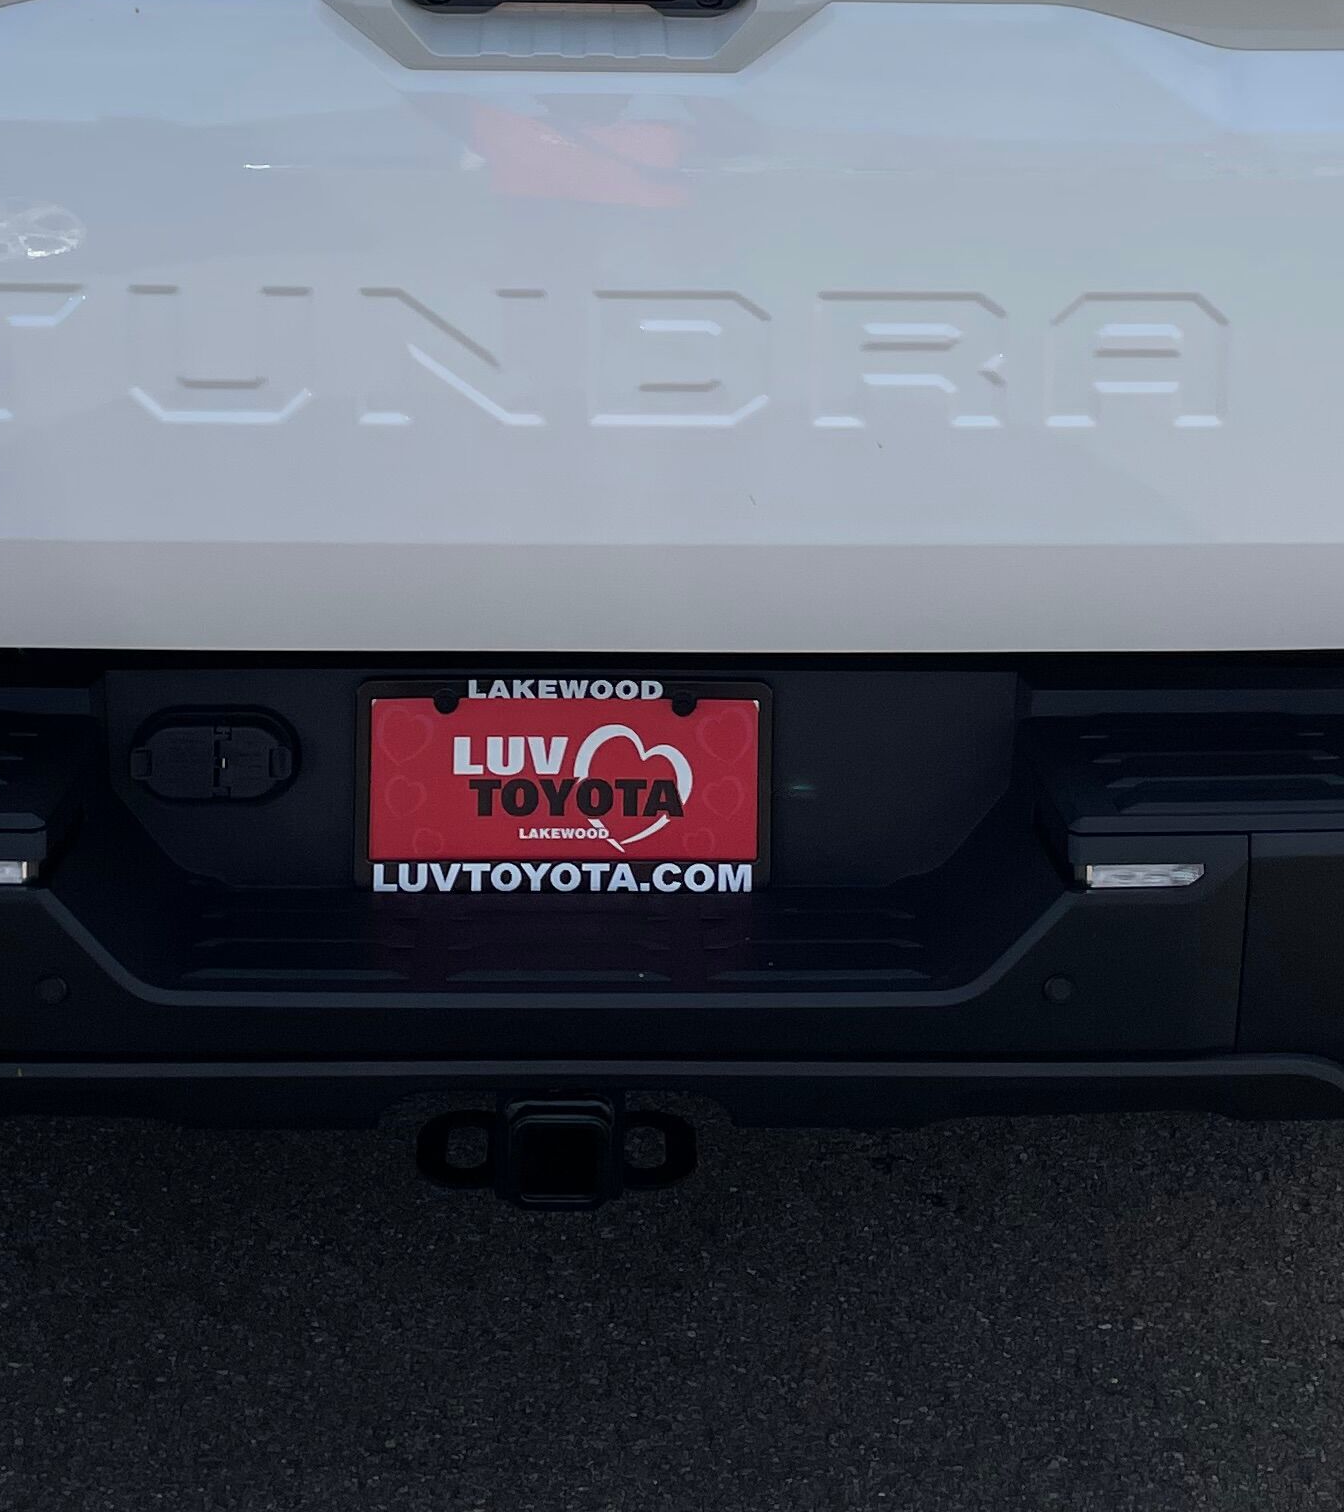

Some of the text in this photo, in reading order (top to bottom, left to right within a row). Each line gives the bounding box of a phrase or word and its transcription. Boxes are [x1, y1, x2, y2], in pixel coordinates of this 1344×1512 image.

[468, 679, 663, 700] LAKEWOOD
[453, 735, 569, 776] LUV
[469, 779, 685, 817] TOYOTA
[519, 828, 610, 839] LAKEWOOD
[373, 863, 753, 893] LUVTOYOTA.COM
